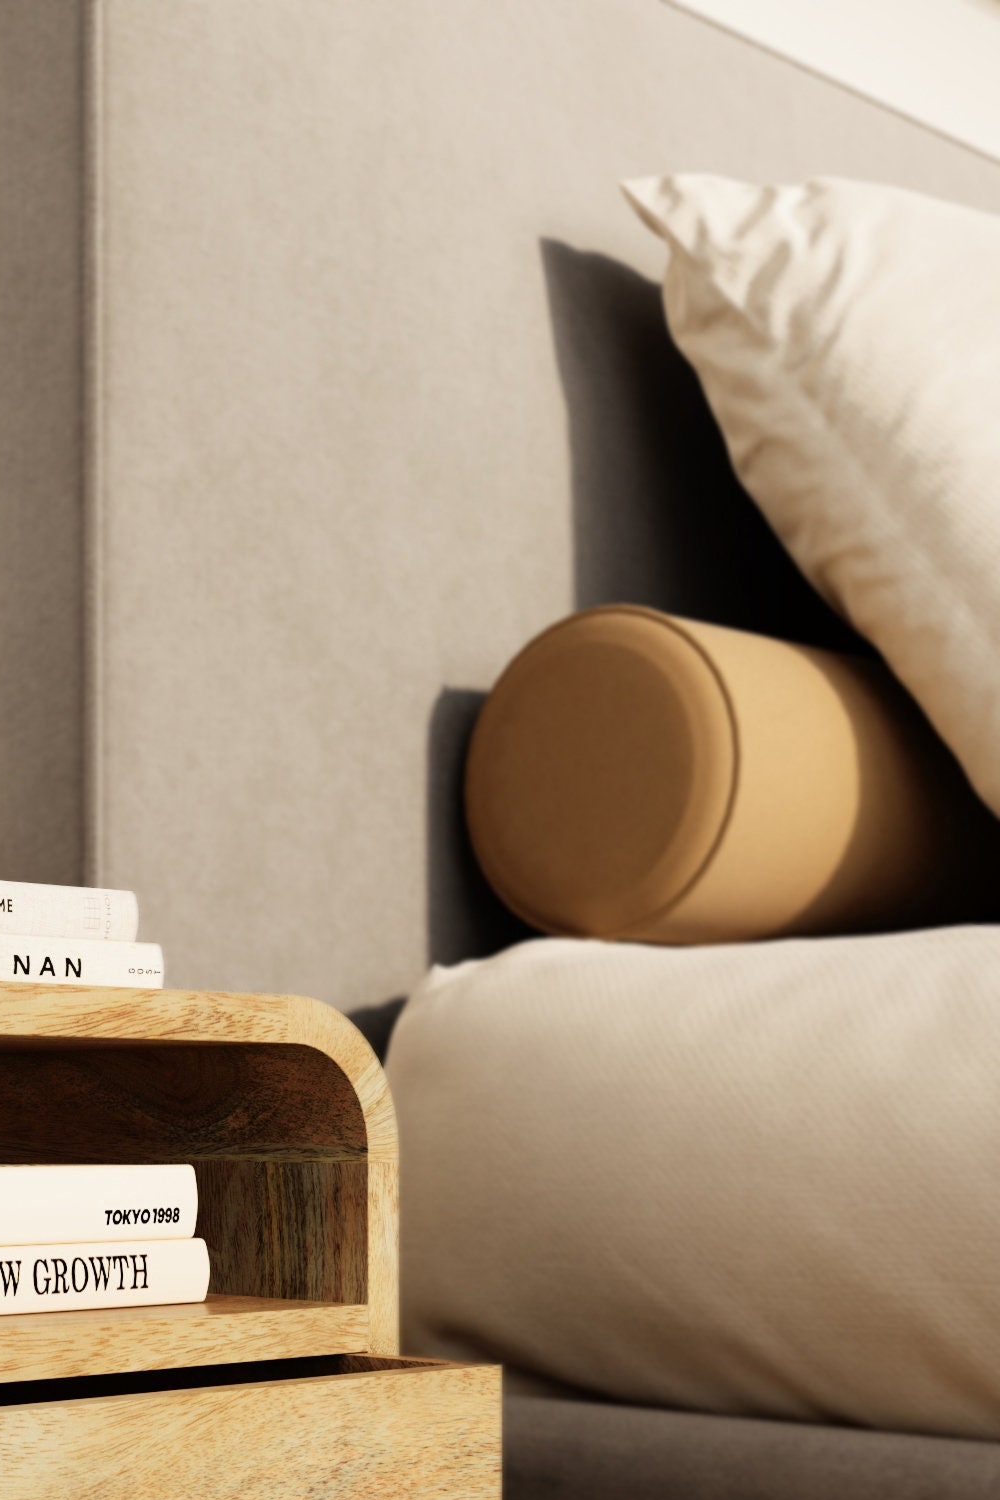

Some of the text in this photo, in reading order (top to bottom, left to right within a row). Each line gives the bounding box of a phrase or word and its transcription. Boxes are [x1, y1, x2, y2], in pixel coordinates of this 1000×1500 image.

[13, 954, 82, 978] NAN
[104, 1207, 180, 1226] TOKYO 1998
[32, 1254, 149, 1295] GROWTH
